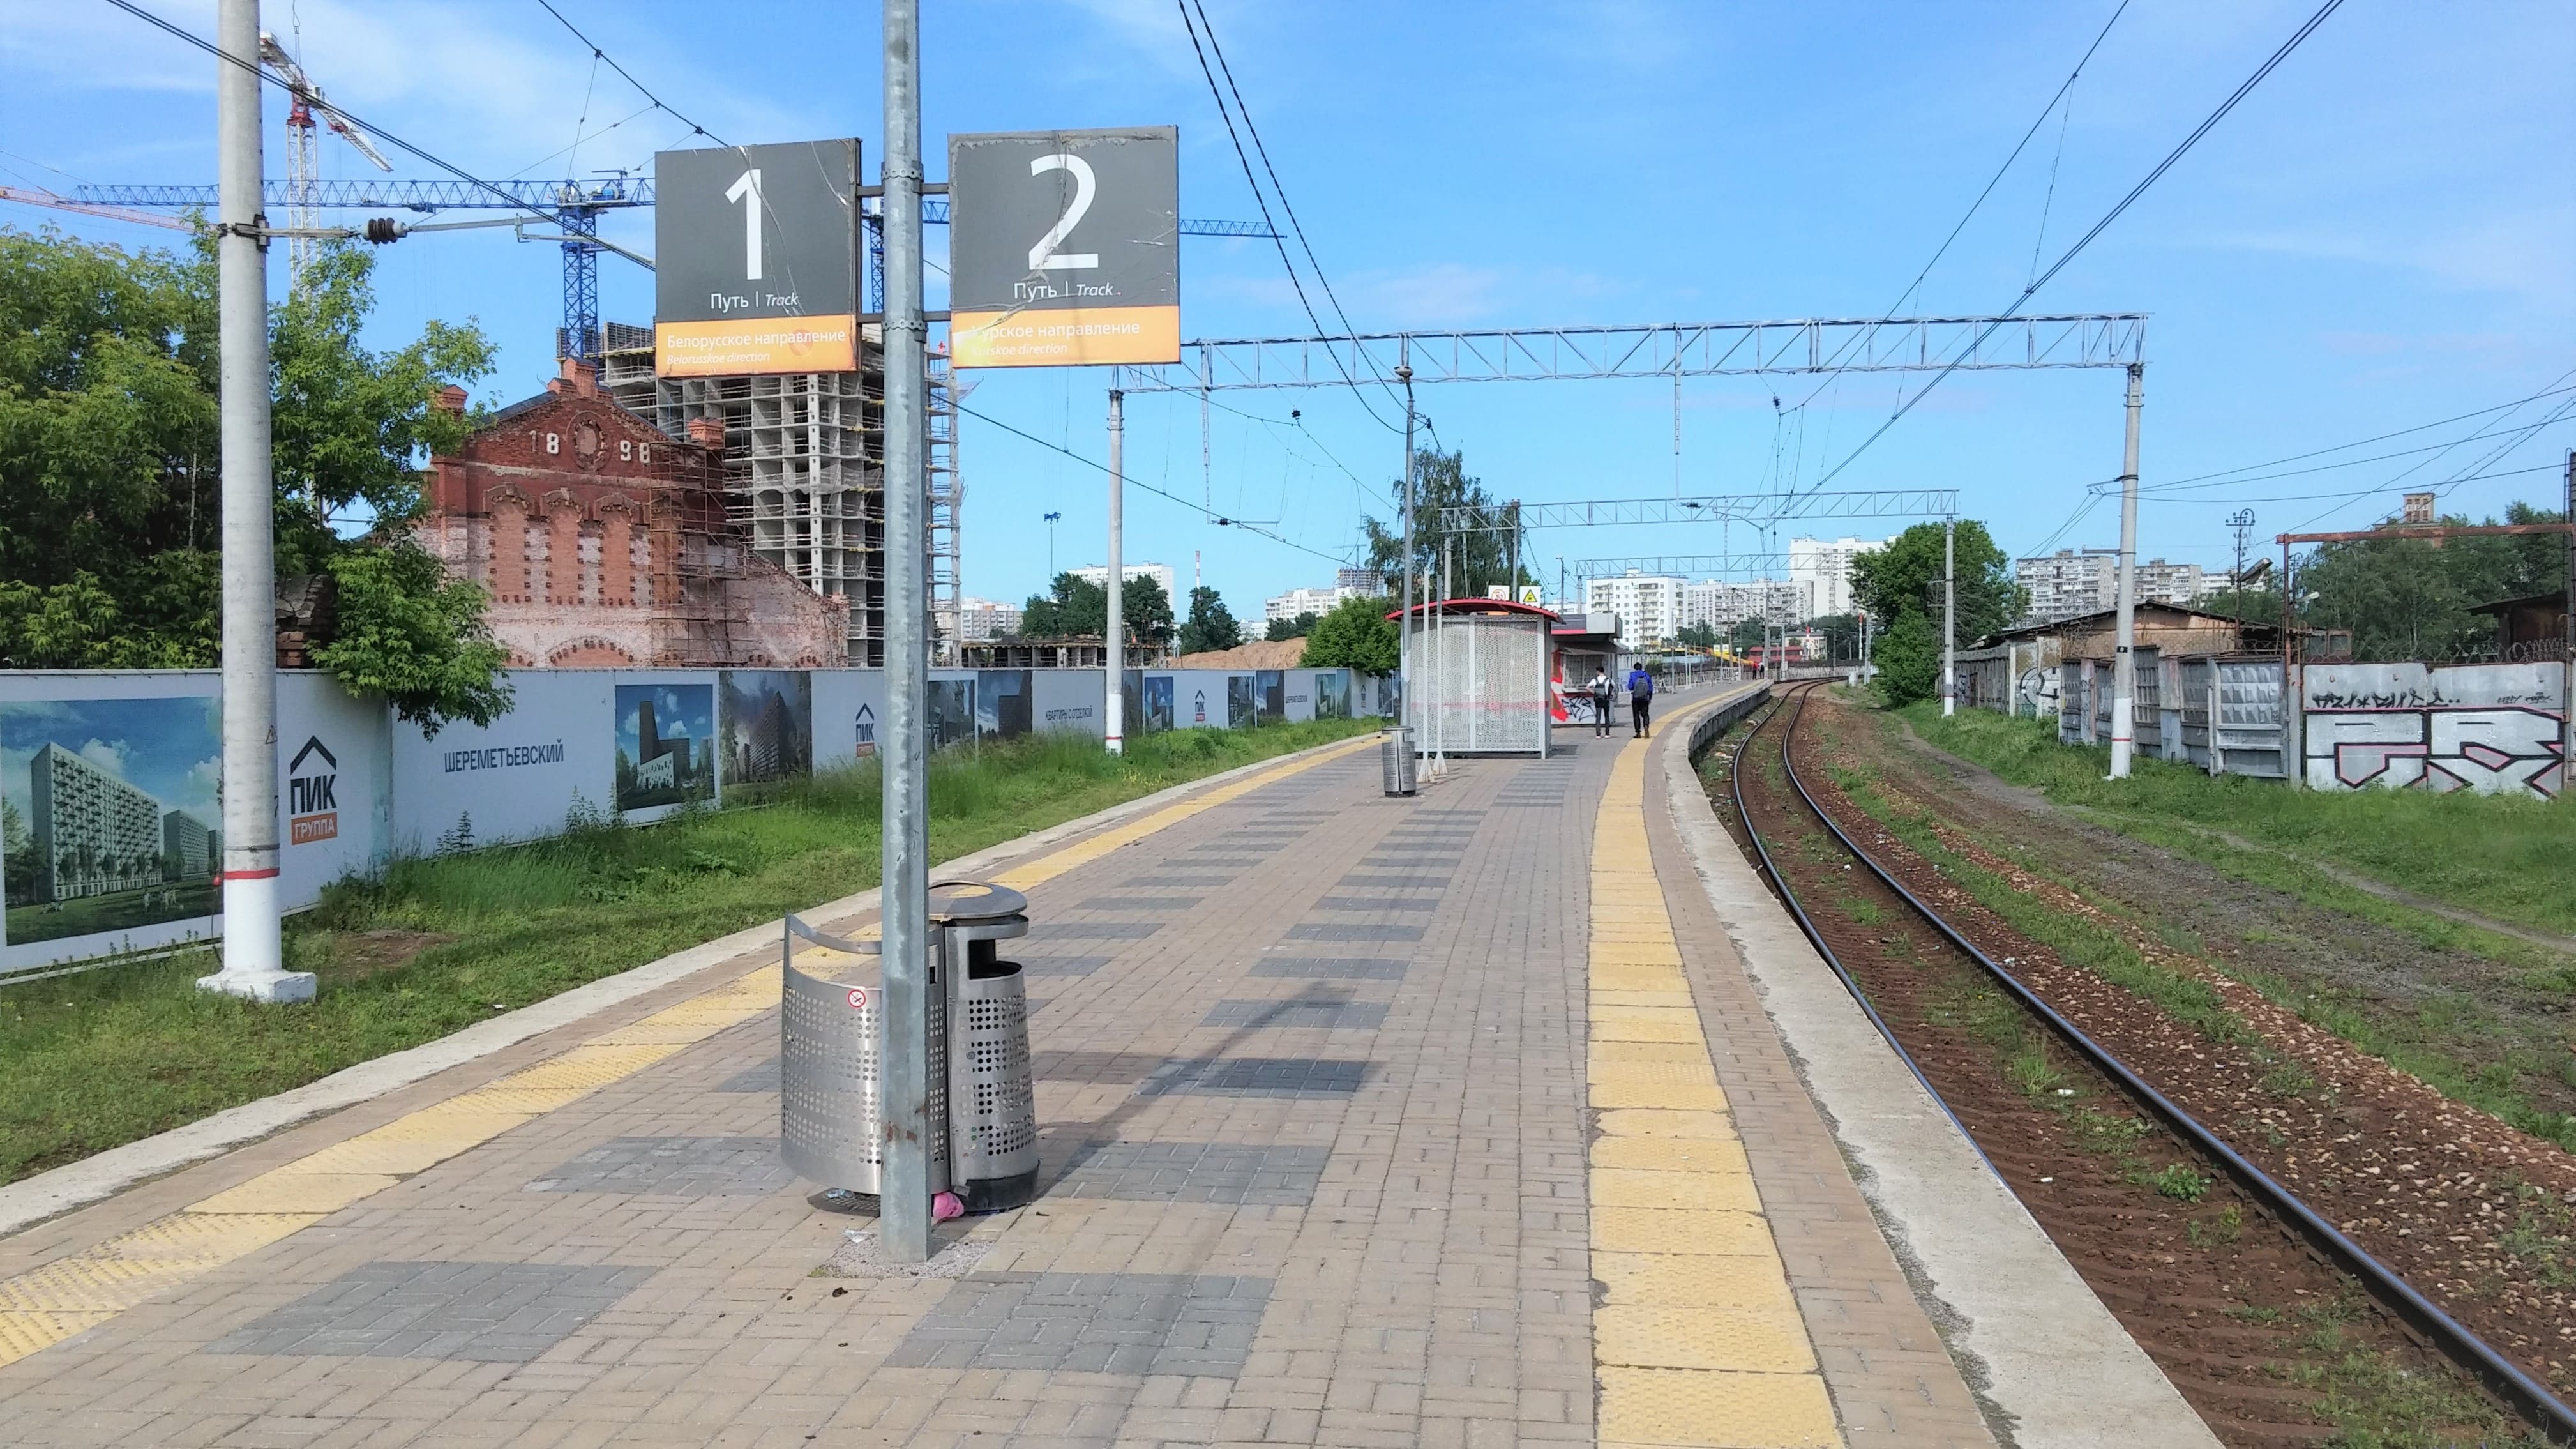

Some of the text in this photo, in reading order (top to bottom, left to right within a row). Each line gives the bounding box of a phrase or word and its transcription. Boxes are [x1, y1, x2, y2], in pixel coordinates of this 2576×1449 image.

[1028, 153, 1099, 271] 2
[725, 168, 762, 280] 1
[710, 292, 798, 313] Путь Track
[1014, 282, 1113, 303] Путь Track
[667, 330, 845, 351] Белорусское направление
[1038, 322, 1140, 339] направление
[667, 351, 770, 365] Belorusskoe direction
[1018, 342, 1067, 354] direction
[619, 439, 651, 464] 98
[855, 722, 875, 742] ПИК
[444, 738, 564, 773] ШЕРЕМЕТЬЕВСКИЙ
[290, 774, 337, 815] ПИК
[294, 817, 336, 839] ГРУППА
